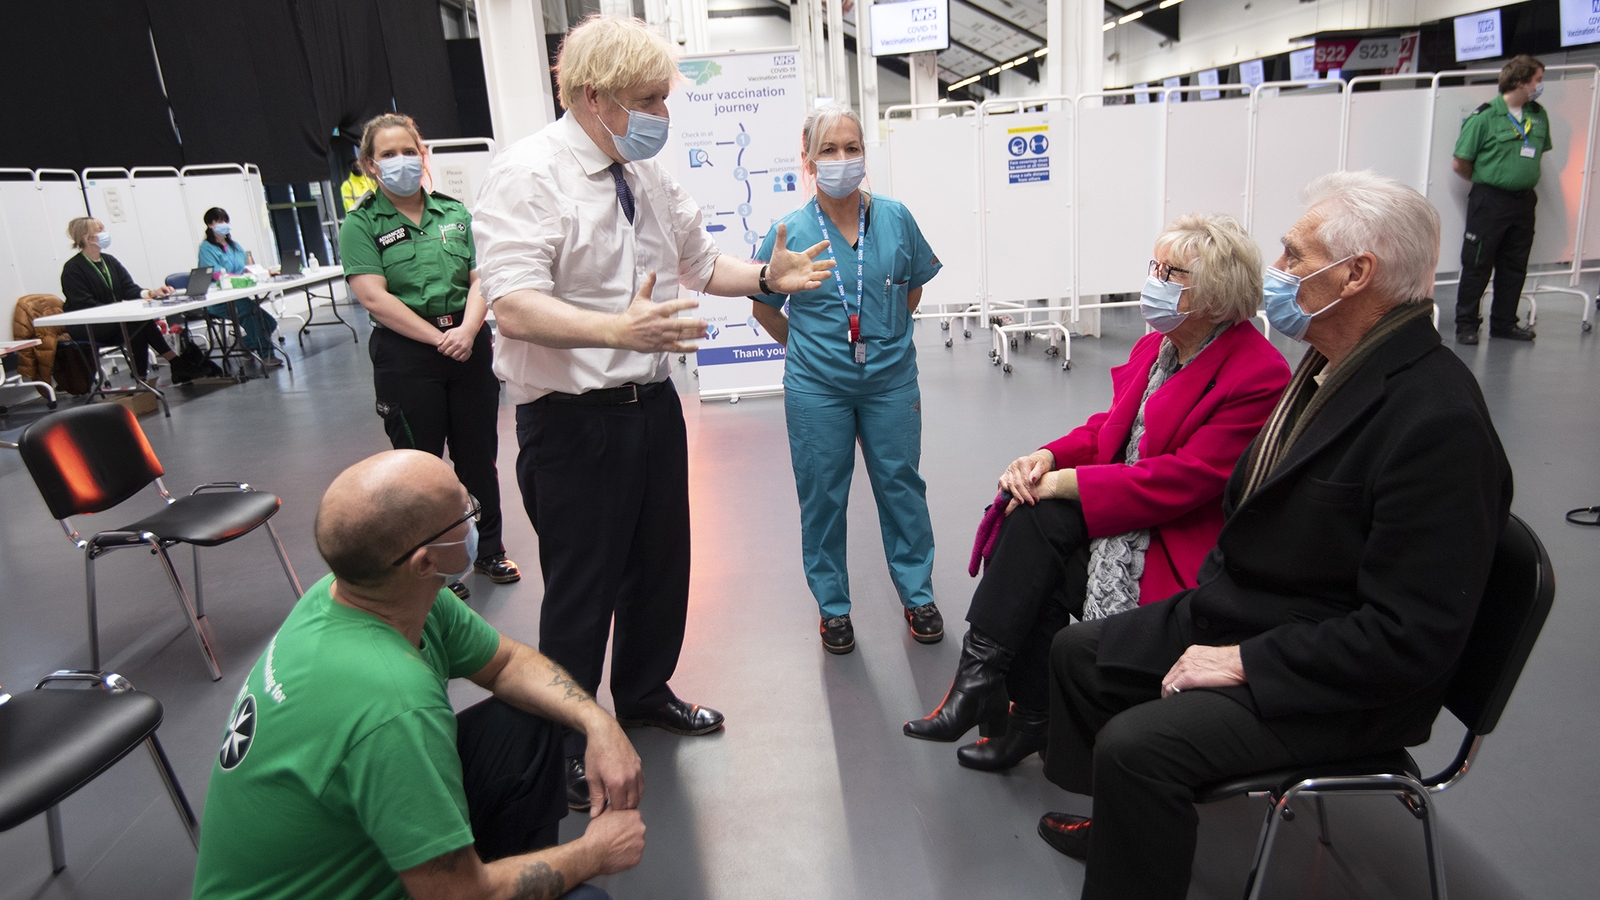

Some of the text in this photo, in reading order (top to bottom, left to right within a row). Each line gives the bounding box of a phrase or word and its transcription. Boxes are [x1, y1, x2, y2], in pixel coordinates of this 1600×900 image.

[912, 7, 936, 22] NHS
[1567, 28, 1596, 38] Vaccination
[880, 37, 915, 46] Vaccination
[1315, 45, 1346, 62] S22
[1359, 44, 1388, 59] S23
[774, 56, 795, 66] NHS
[686, 87, 785, 102] Your vaccination
[714, 103, 759, 116] journey
[681, 131, 700, 139] Check
[684, 140, 712, 148] reception
[737, 170, 744, 178] 2
[742, 206, 748, 215] 3
[379, 227, 405, 243] ADVANCED
[382, 232, 406, 246] FIRST AID
[747, 232, 754, 241] 4
[733, 348, 785, 358] Thank you
[271, 683, 286, 703] for
